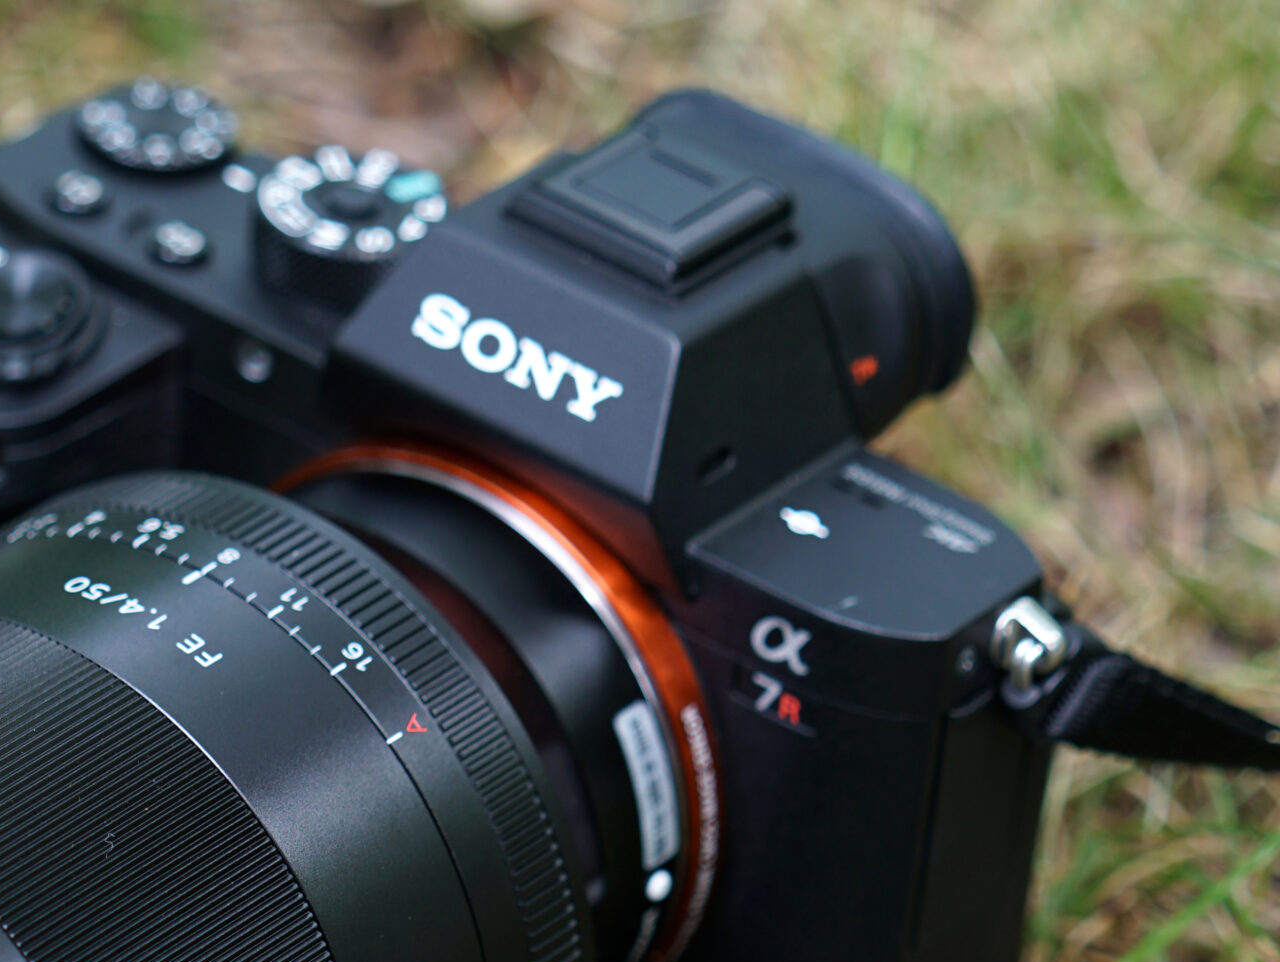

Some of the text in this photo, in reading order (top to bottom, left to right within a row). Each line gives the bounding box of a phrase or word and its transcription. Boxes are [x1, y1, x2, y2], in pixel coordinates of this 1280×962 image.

[411, 294, 623, 421] SONY
[218, 547, 241, 565] 8
[280, 588, 309, 612] 11
[64, 576, 223, 668] FE 1.4/50
[341, 641, 374, 672] 16
[405, 713, 428, 733] A
